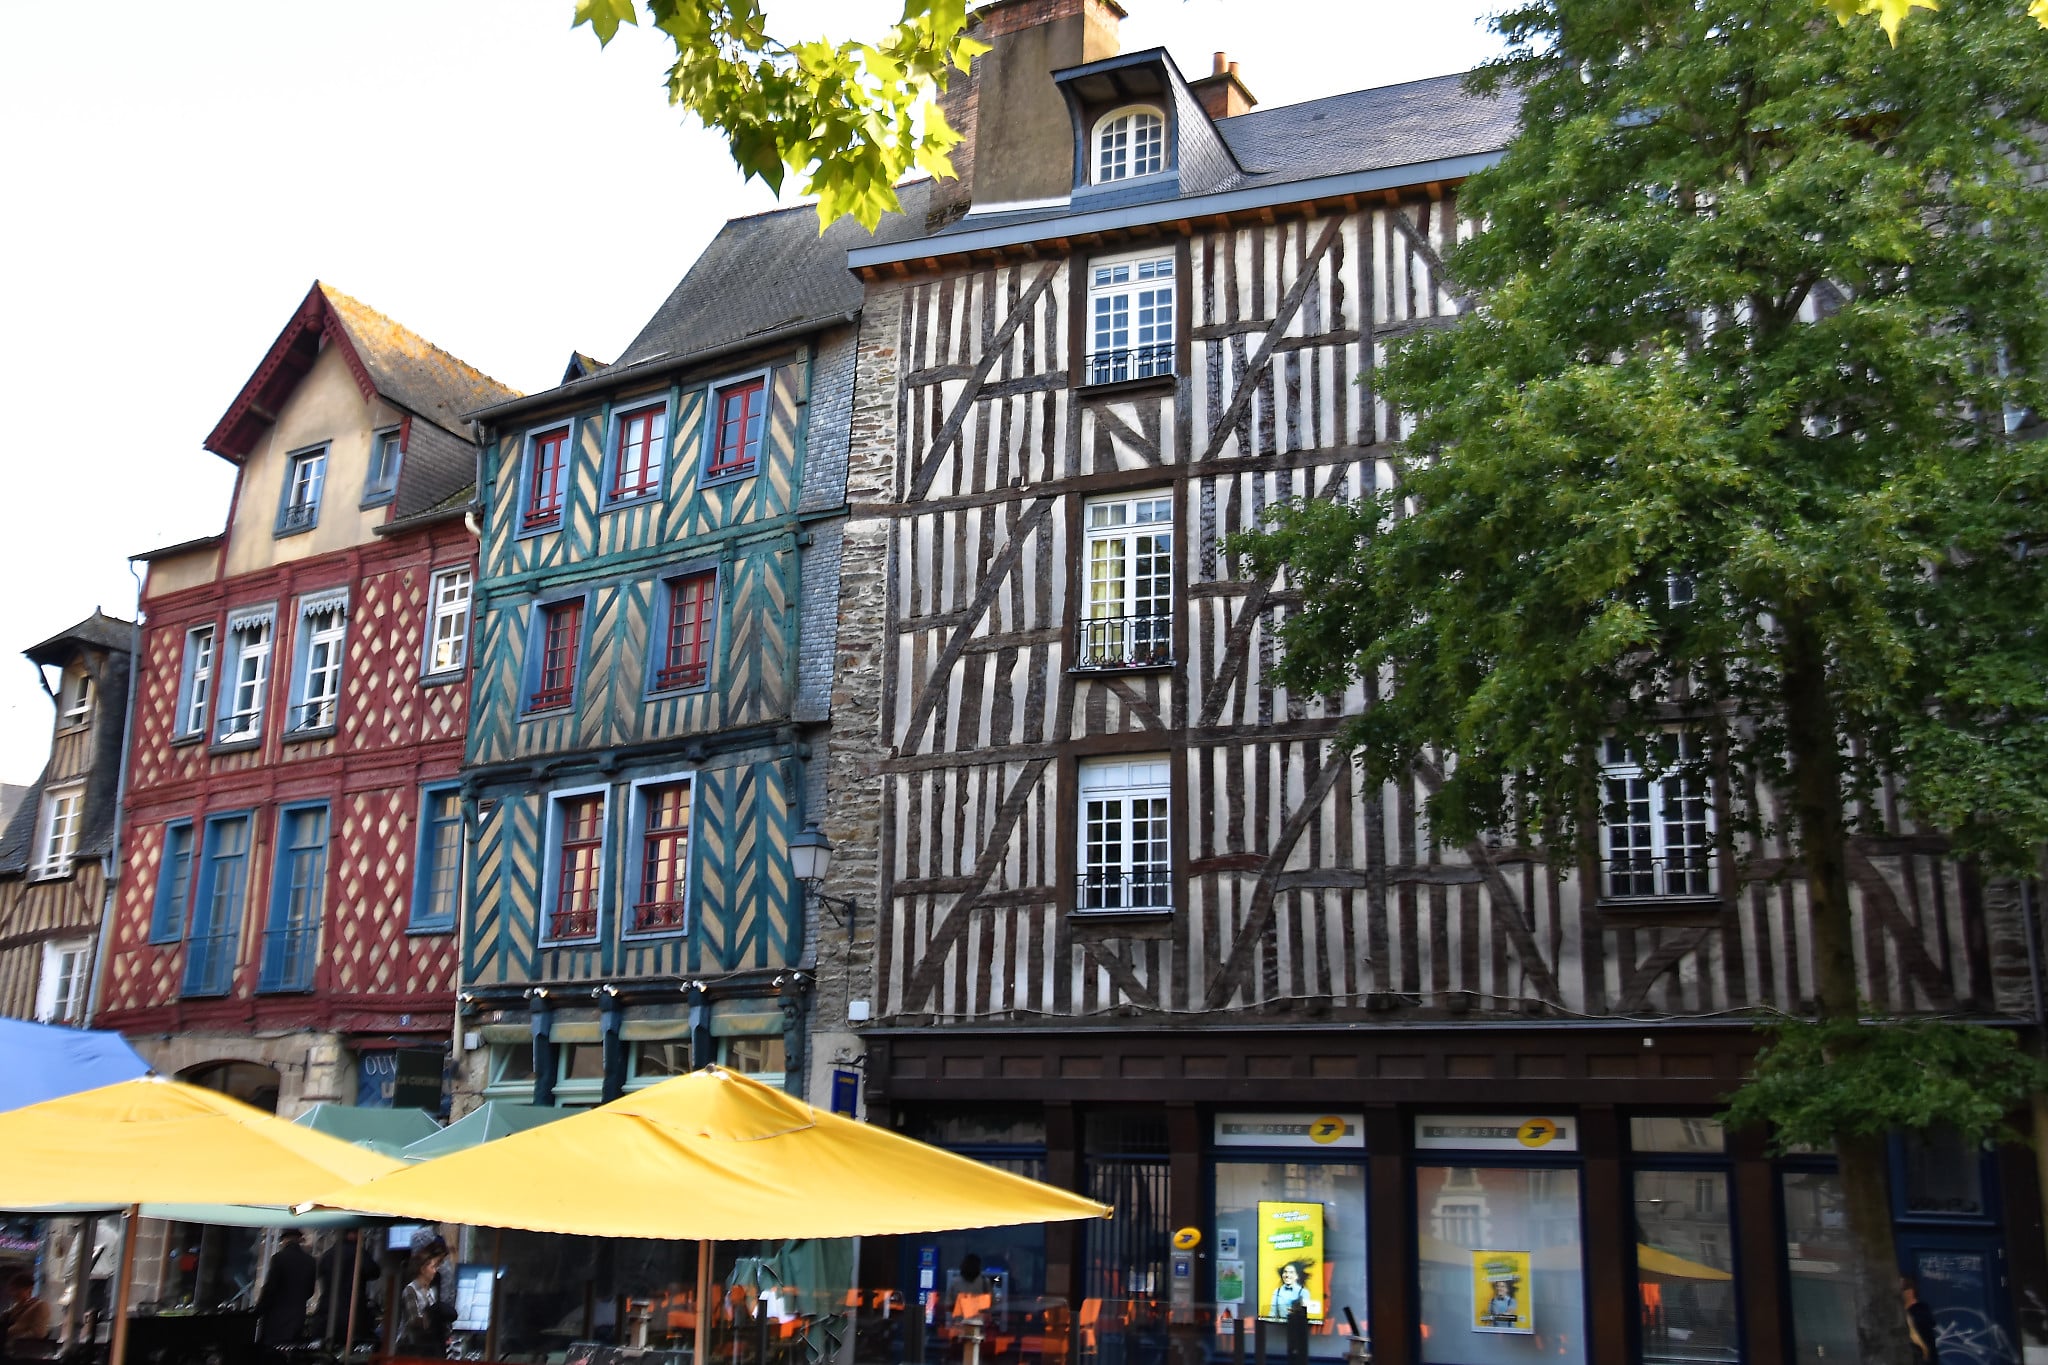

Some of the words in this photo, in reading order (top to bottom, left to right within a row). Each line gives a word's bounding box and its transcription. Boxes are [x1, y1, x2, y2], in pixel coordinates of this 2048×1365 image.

[1231, 1125, 1249, 1134] LA
[1256, 1125, 1302, 1134] POSTE
[1432, 1127, 1452, 1136] LA
[1457, 1127, 1509, 1137] POSTE
